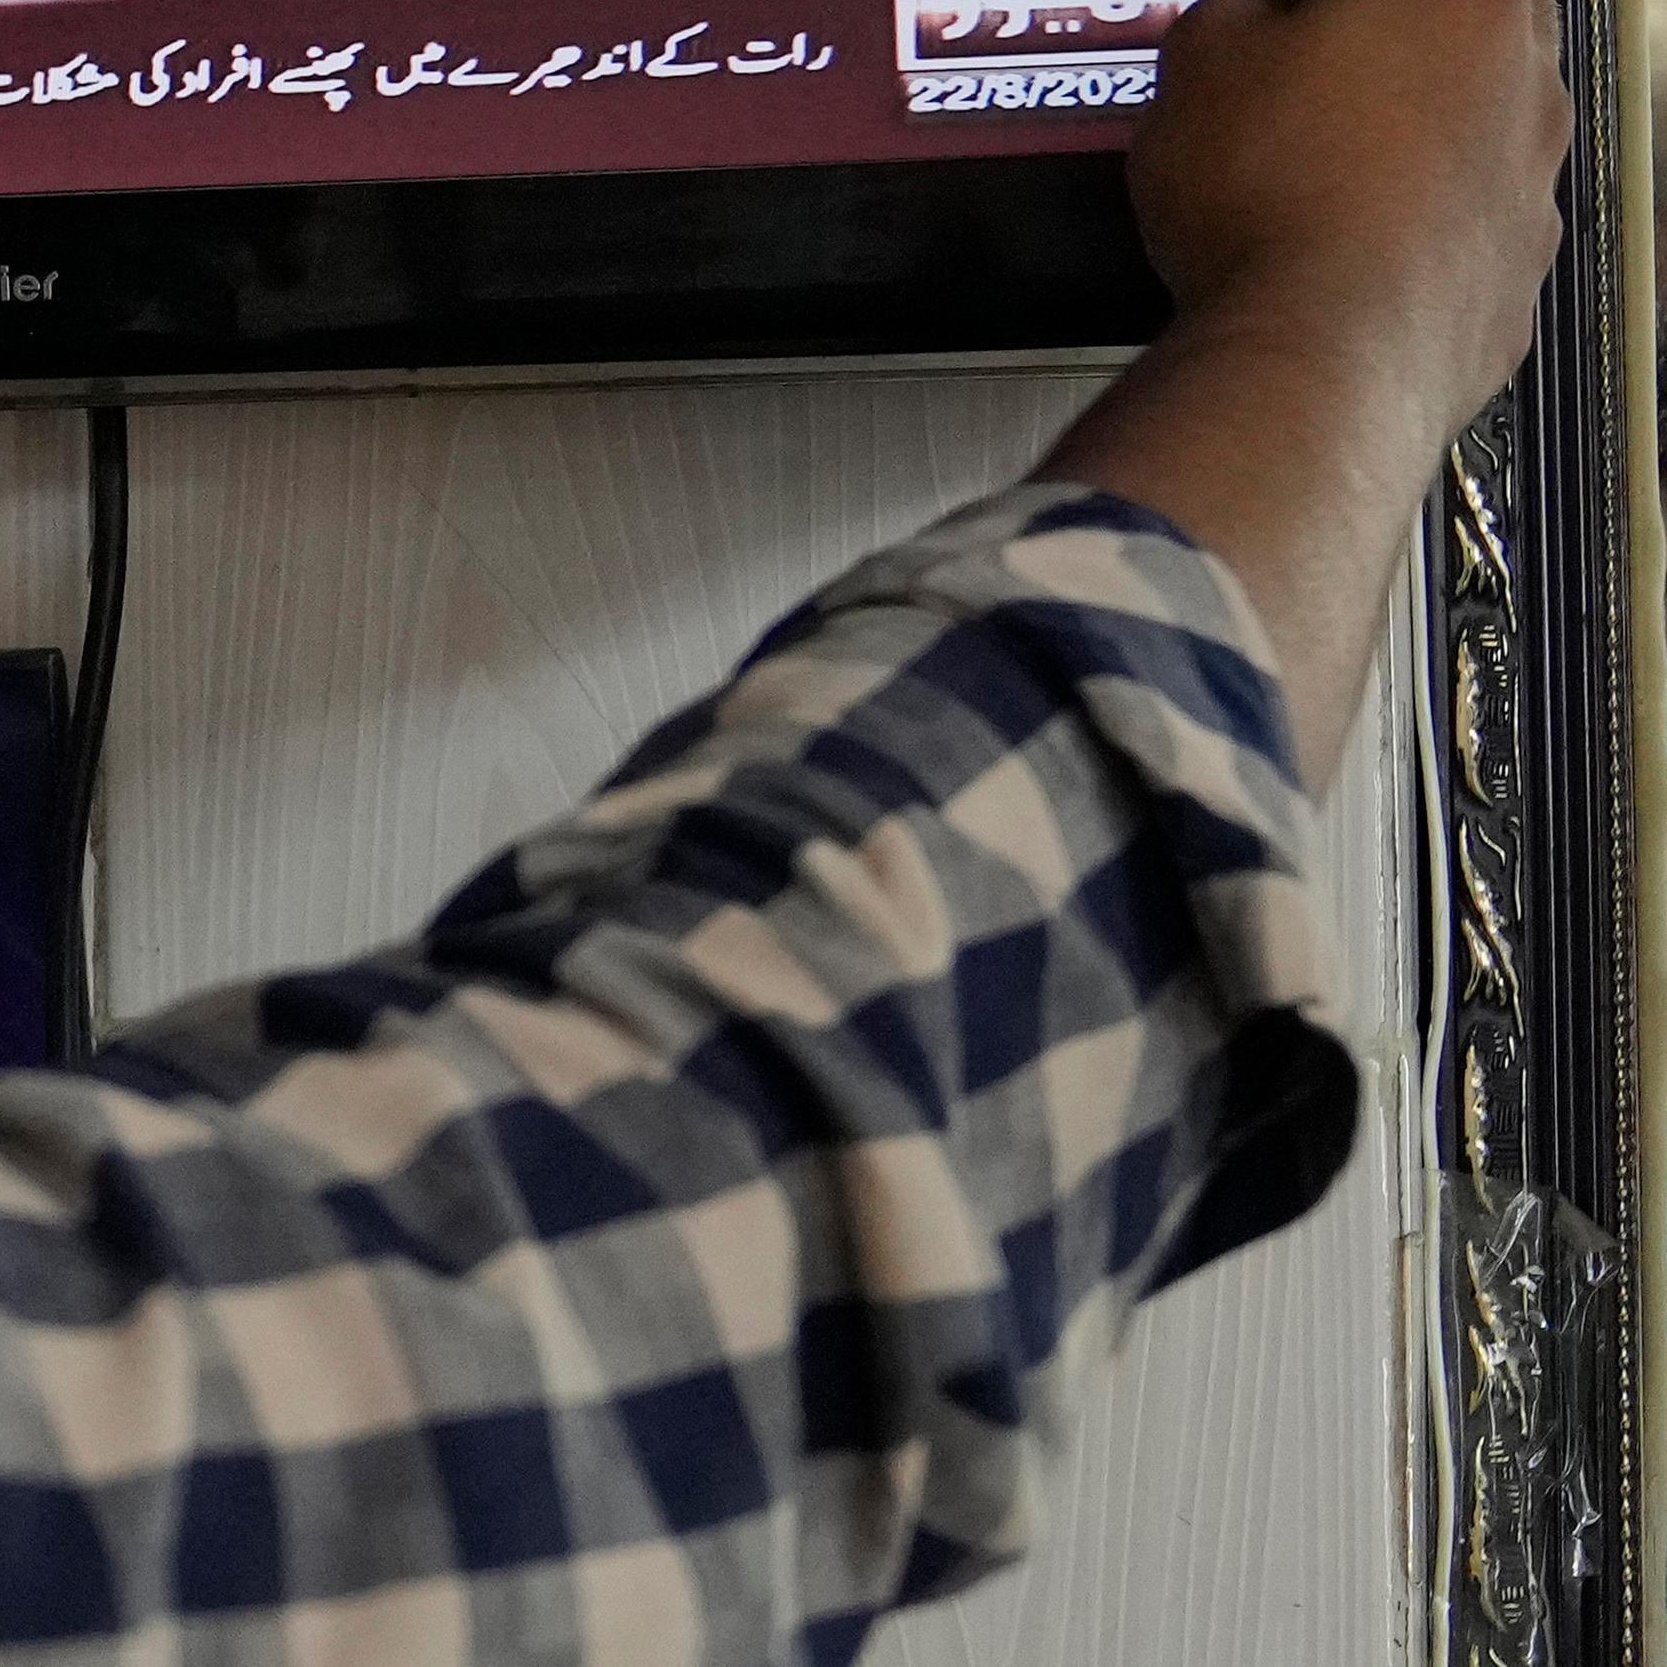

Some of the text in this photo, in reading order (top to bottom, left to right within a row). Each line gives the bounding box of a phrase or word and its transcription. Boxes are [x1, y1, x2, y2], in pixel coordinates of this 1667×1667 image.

[128, 39, 186, 107] کی
[175, 43, 263, 103] افراد
[267, 42, 365, 112] پھنسے
[374, 41, 446, 96] میں
[643, 22, 720, 78] کے
[727, 31, 833, 74] رات
